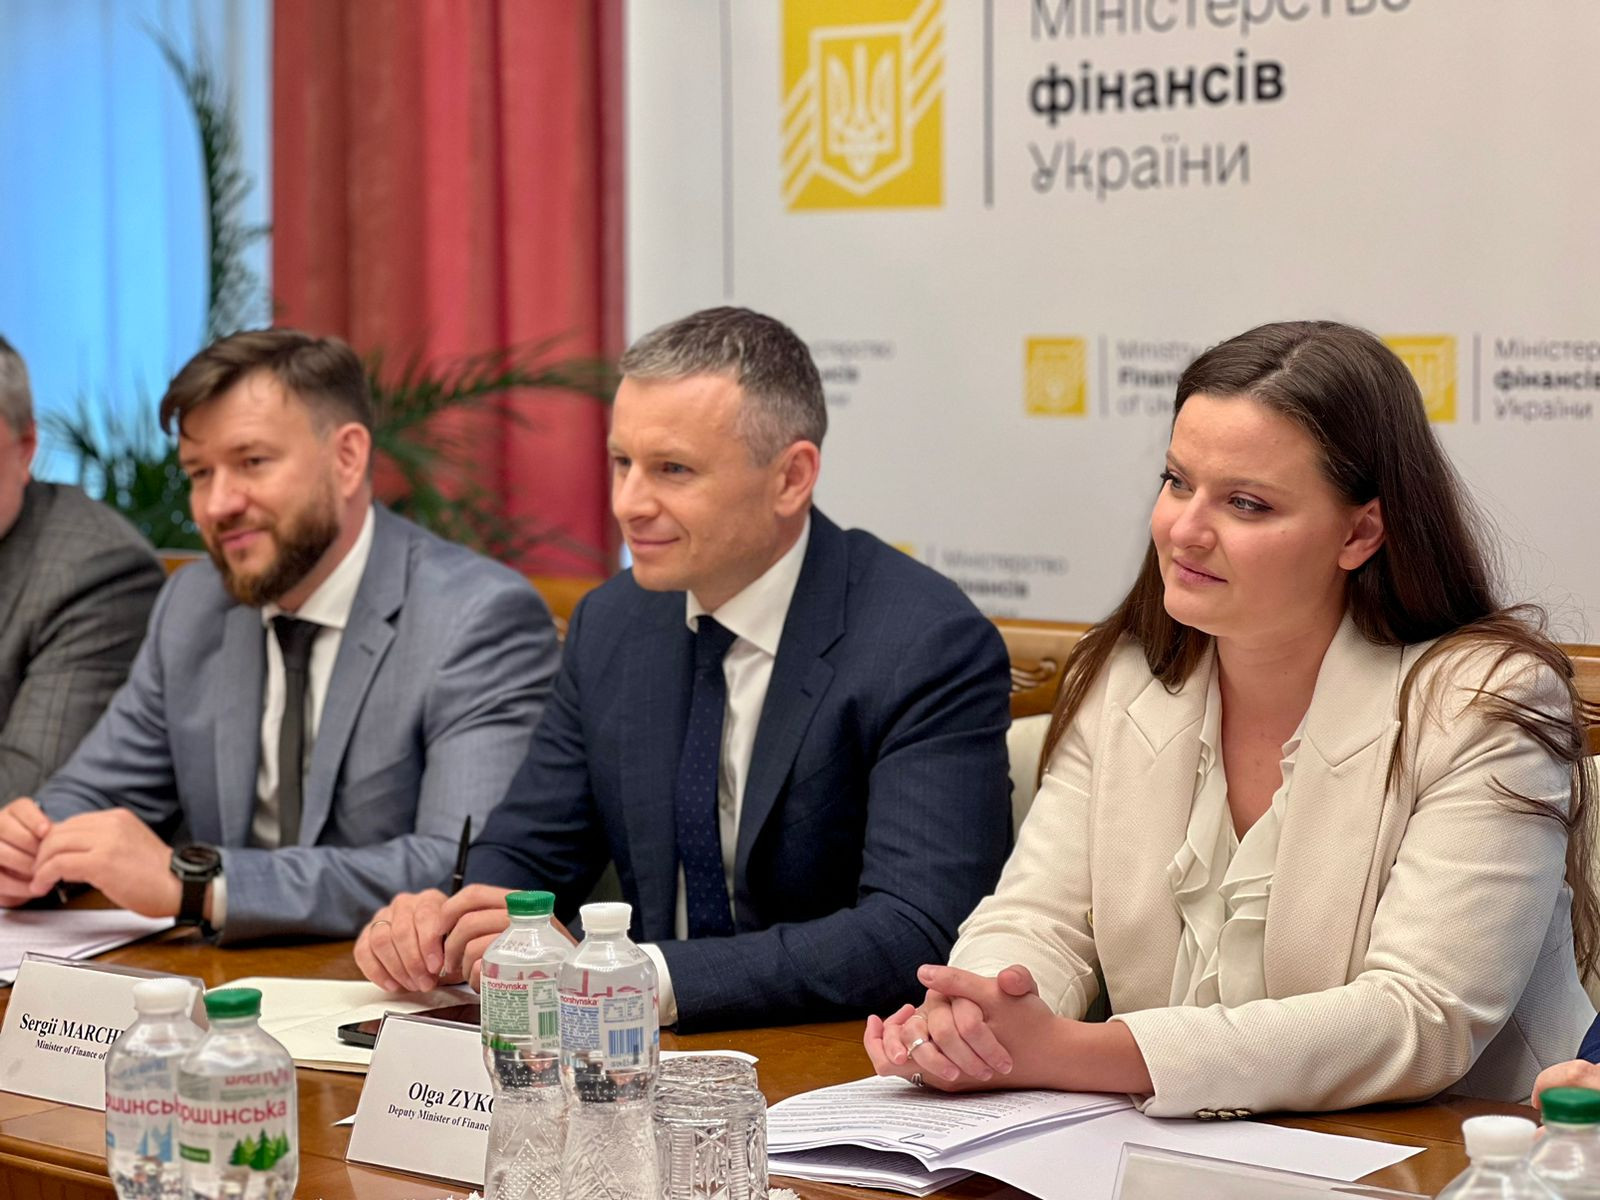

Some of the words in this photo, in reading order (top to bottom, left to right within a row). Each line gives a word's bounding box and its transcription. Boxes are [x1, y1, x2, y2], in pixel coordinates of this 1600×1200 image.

[1029, 50, 1287, 126] фінансів
[1028, 133, 1251, 200] України
[1494, 338, 1600, 362] Міністер
[20, 1013, 58, 1037] Sergii
[59, 1020, 125, 1045] MARCH
[36, 1039, 63, 1053] Minister
[63, 1045, 73, 1054] of
[71, 1046, 97, 1059] Finance
[98, 1051, 108, 1061] of
[409, 1082, 445, 1108] Olga
[178, 1099, 287, 1126] ршинська
[388, 1104, 416, 1120] Deputy
[417, 1110, 451, 1125] Minister
[451, 1116, 463, 1127] of
